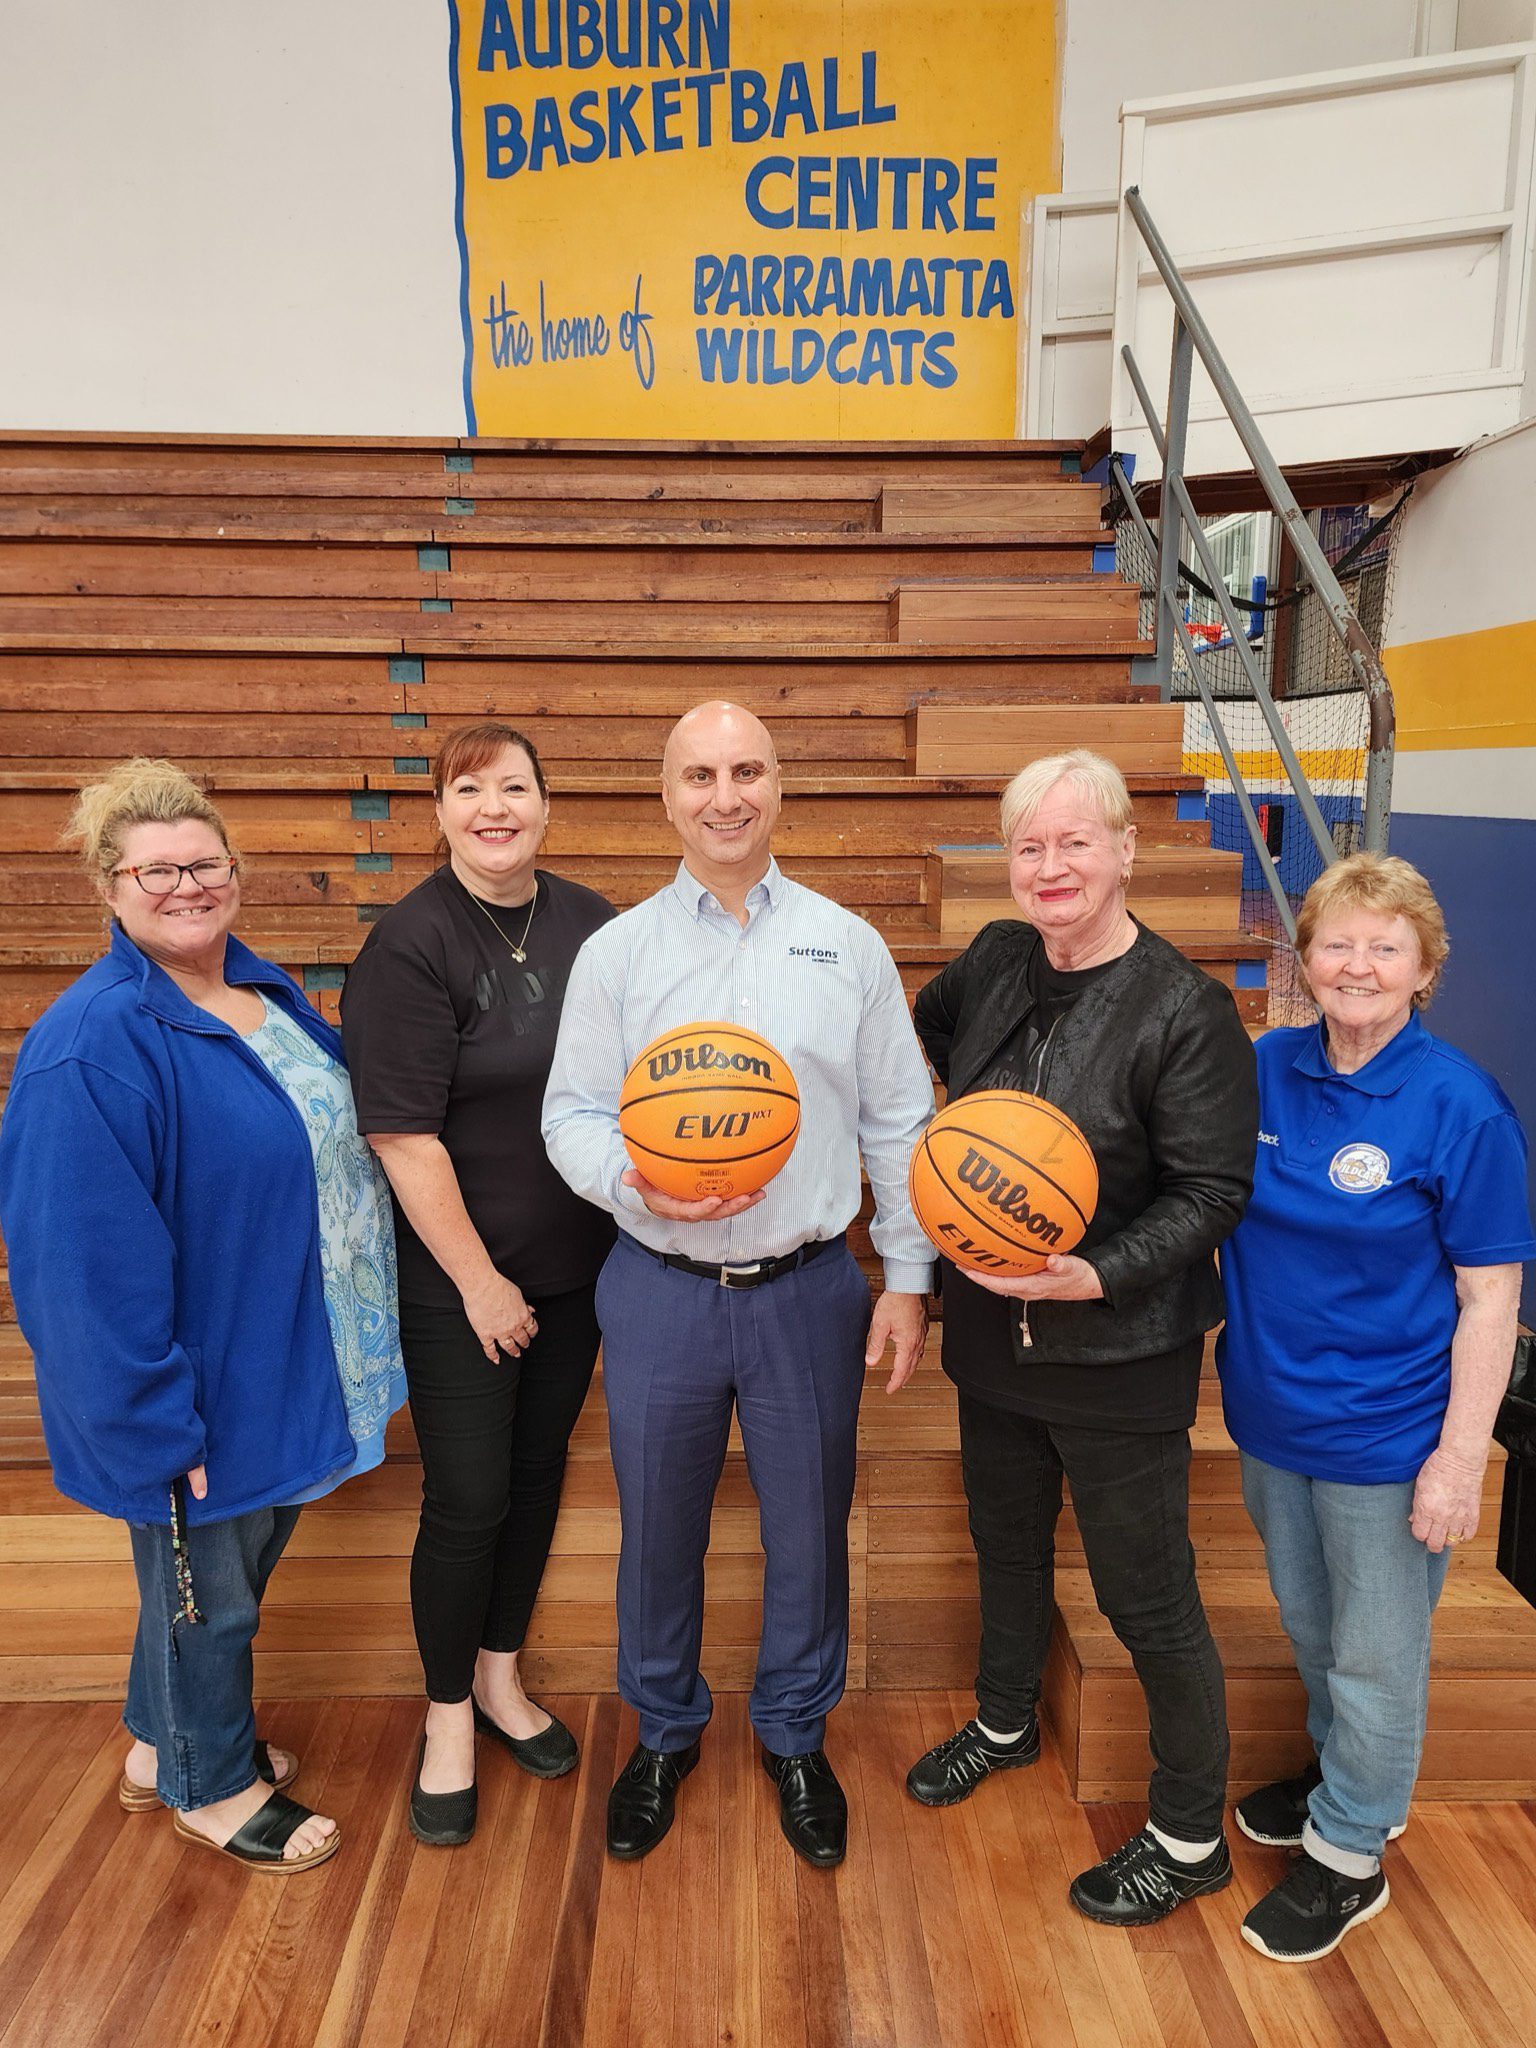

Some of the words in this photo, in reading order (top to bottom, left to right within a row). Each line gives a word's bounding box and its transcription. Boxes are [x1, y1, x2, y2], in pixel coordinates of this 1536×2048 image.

[478, 0, 730, 72] AUBURN
[484, 51, 896, 180] BASKETBALL
[745, 156, 997, 233] CENTRE
[693, 253, 1015, 319] PARRAMATTA
[483, 280, 533, 369] the
[540, 280, 610, 362] home
[619, 274, 655, 390] of
[696, 327, 959, 389] WILDCATS
[788, 946, 839, 959] Suttons
[647, 1043, 775, 1082] Wilson
[674, 1112, 751, 1139] EVO
[957, 1146, 1065, 1248] Wilson
[937, 1222, 1010, 1268] EVO
